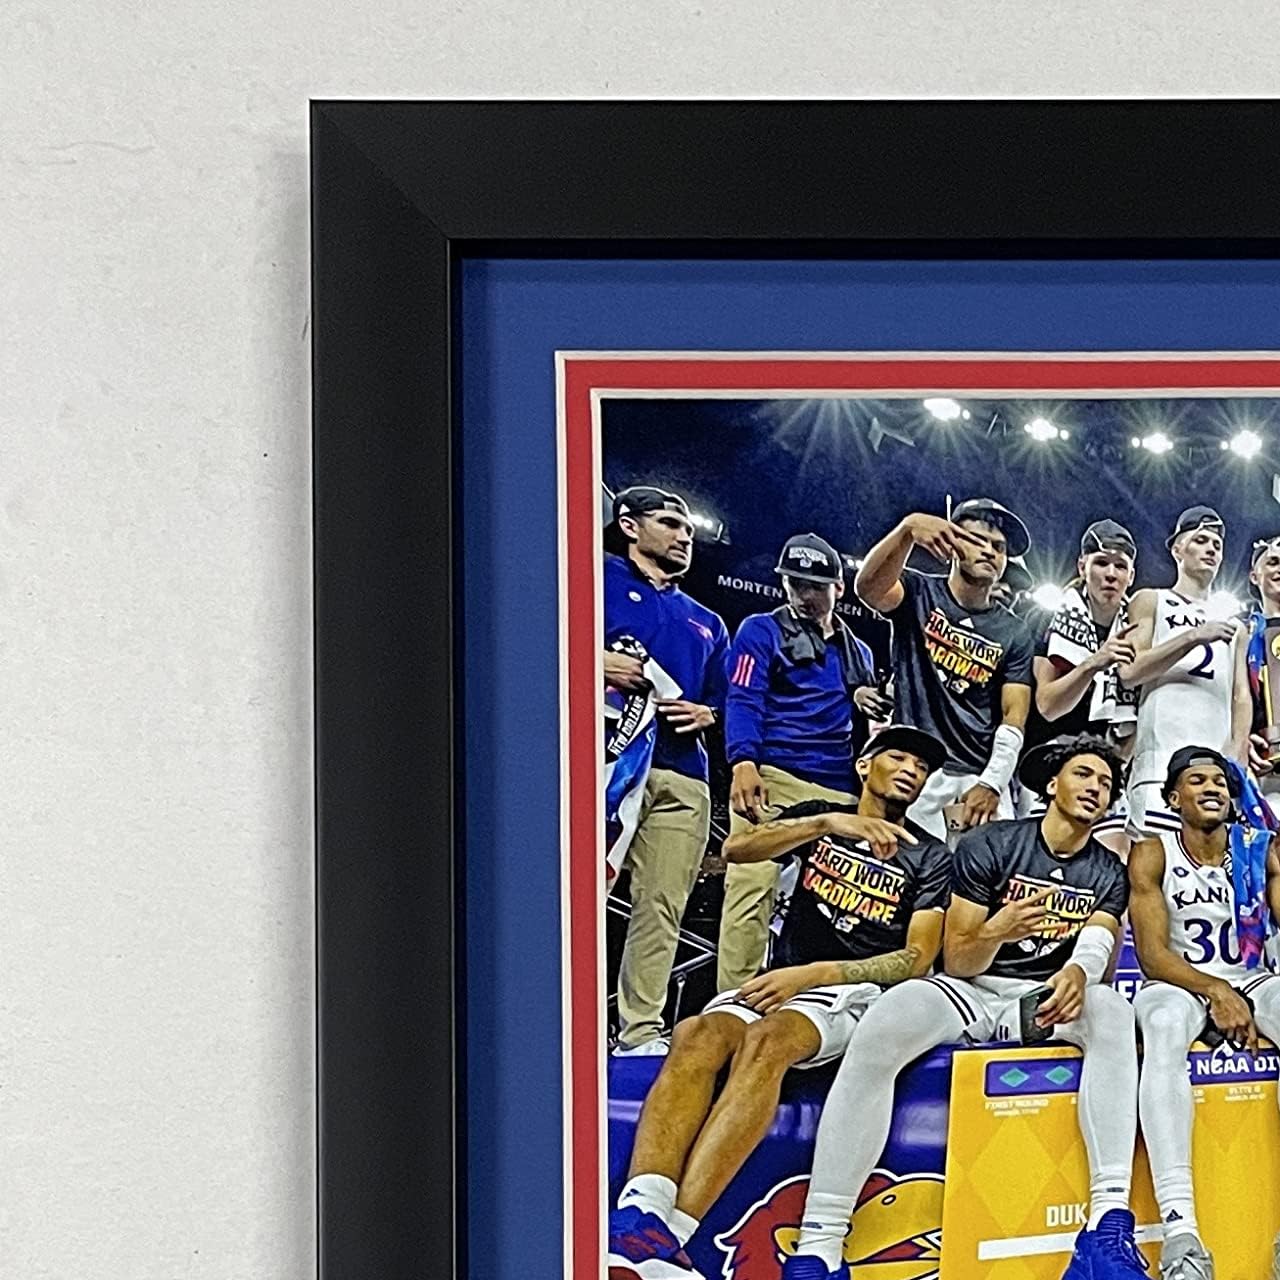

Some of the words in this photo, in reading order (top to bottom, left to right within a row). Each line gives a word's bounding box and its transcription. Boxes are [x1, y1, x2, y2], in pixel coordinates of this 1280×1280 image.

[717, 575, 783, 598] MORTEN
[1187, 642, 1214, 679] 2
[852, 862, 905, 898] WORK
[1183, 918, 1243, 965] 30
[1196, 1057, 1250, 1076] NCAA
[1046, 1203, 1089, 1228] DUK
